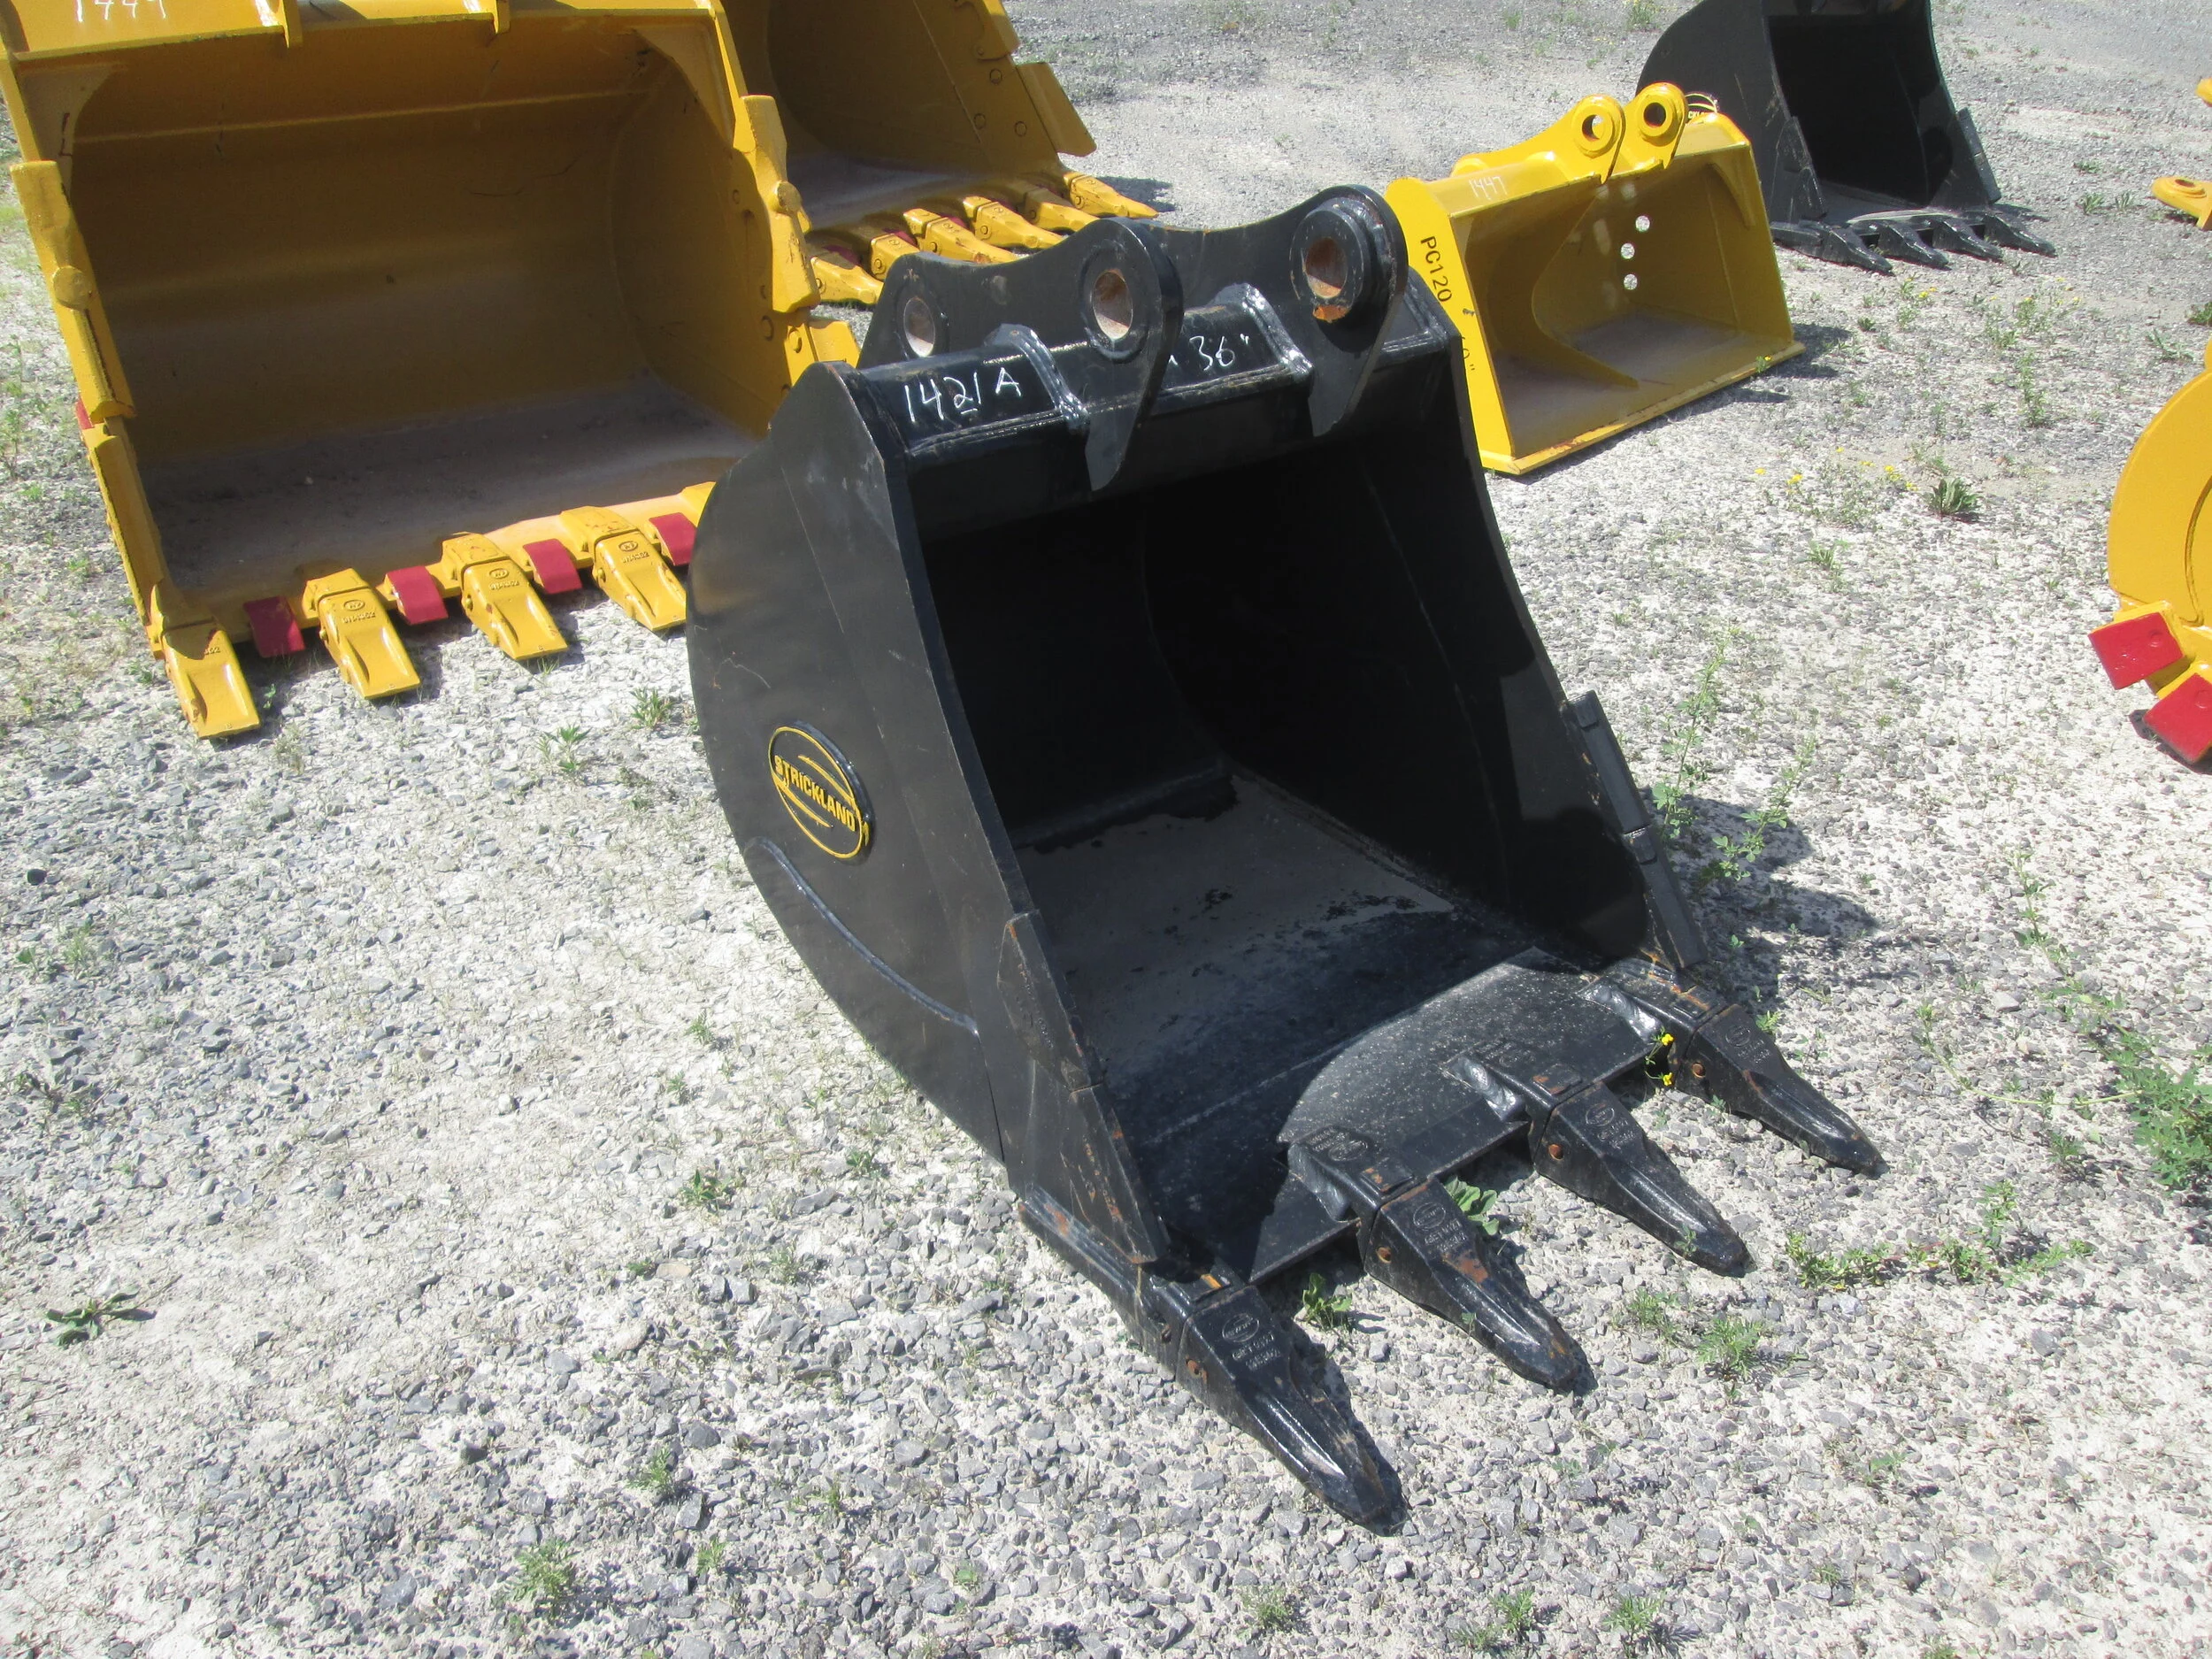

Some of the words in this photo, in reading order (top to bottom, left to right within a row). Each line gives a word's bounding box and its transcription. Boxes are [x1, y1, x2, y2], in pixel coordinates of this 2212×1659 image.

[1468, 176, 1509, 200] 1447
[1420, 235, 1452, 303] PC120
[904, 372, 981, 422] 1421
[995, 366, 1022, 396] A
[773, 755, 856, 832] STRICKLAND
